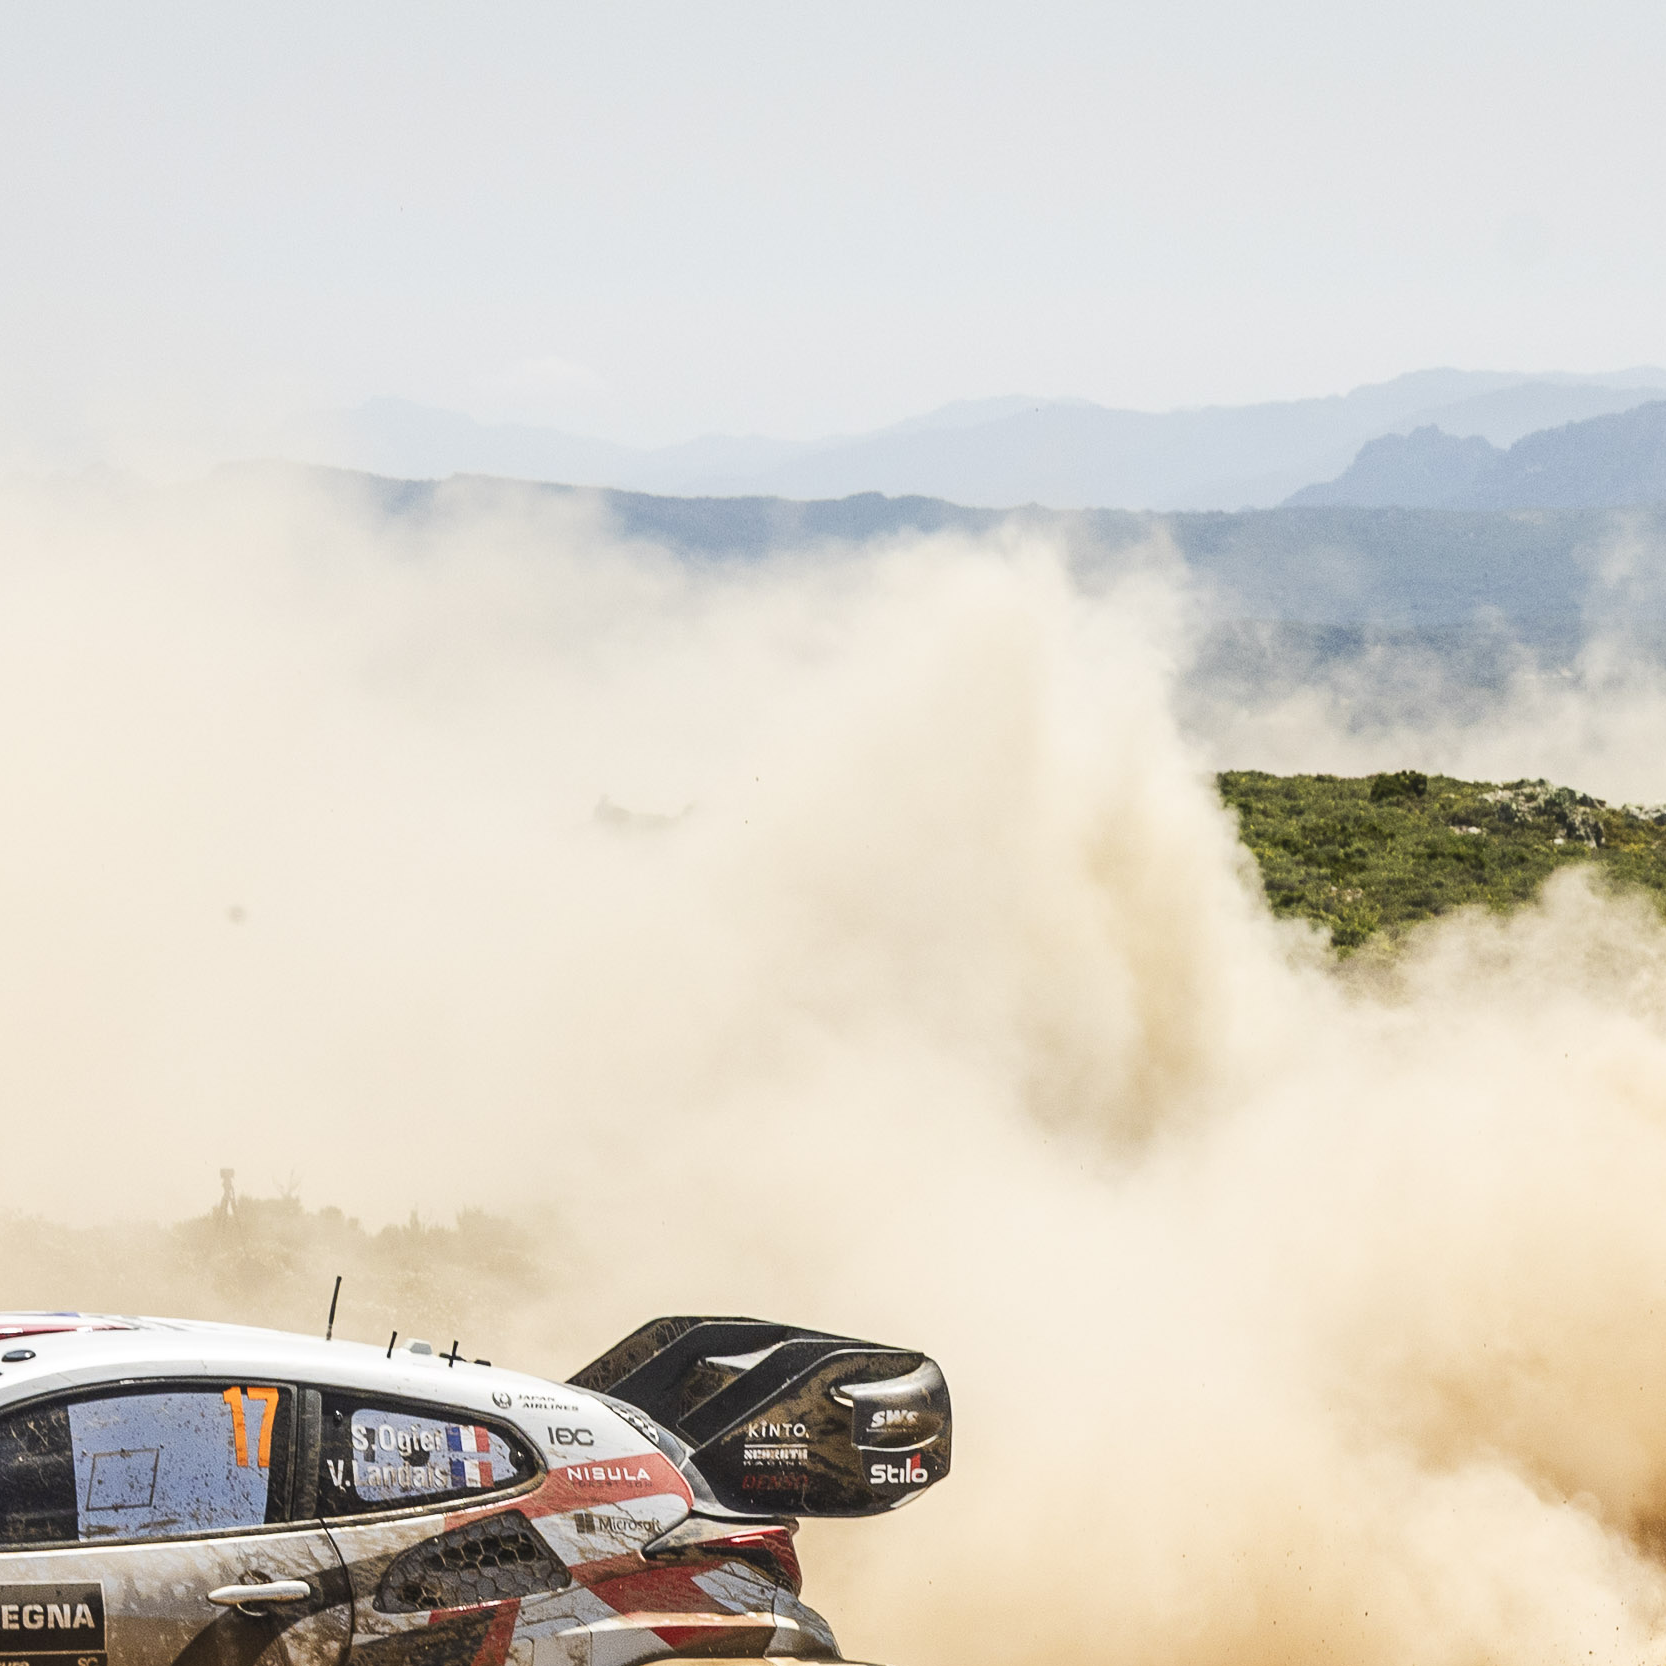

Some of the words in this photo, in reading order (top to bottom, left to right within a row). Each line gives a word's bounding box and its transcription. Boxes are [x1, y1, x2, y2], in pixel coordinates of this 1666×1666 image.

[522, 1402, 579, 1411] AIRLINES
[222, 1387, 279, 1467] 17
[566, 1466, 651, 1481] NISULA
[870, 1457, 928, 1484] Stilo
[599, 1517, 661, 1533] Microsoft
